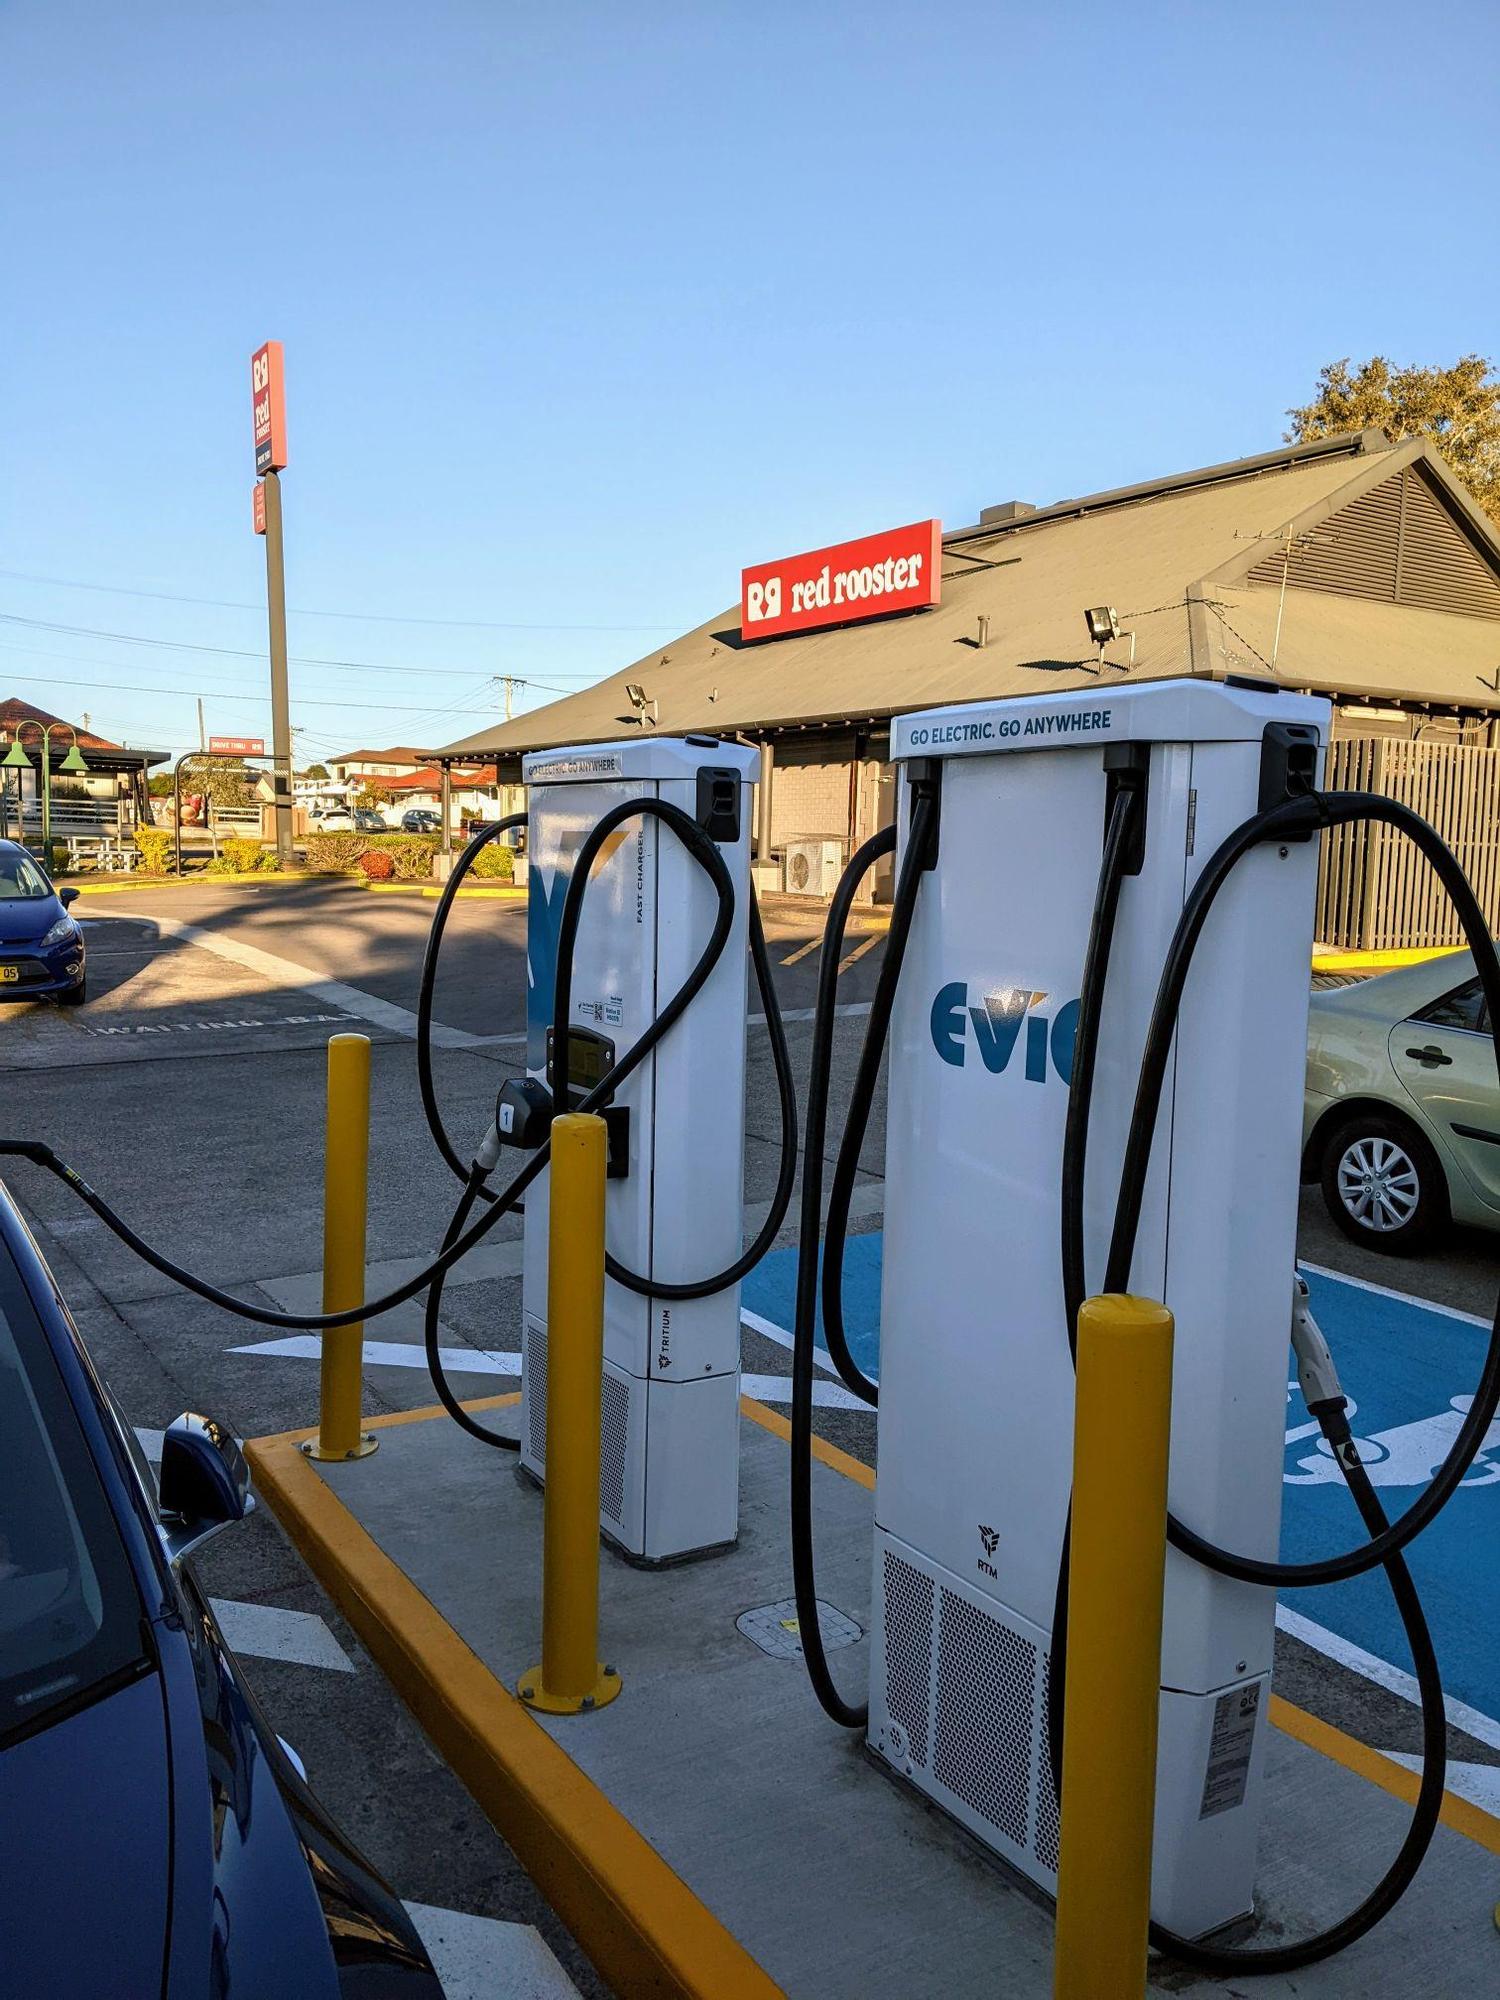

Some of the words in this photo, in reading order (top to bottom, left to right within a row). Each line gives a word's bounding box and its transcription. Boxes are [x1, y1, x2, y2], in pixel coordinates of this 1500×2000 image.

[255, 392, 270, 428] red
[791, 565, 831, 613] red
[833, 553, 922, 604] rooster
[910, 729, 929, 746] GO
[931, 722, 996, 744] ELECTRIC.
[999, 719, 1021, 737] GO
[1023, 710, 1112, 735] ANYWHERE
[578, 758, 616, 773] ANYWHERE
[637, 829, 645, 890] CHARGER
[95, 1020, 265, 1035] WAITING
[281, 1013, 362, 1024] BAY
[504, 1111, 509, 1126] 1
[661, 1309, 671, 1353] TRITIUM
[977, 1558, 998, 1580] RTM
